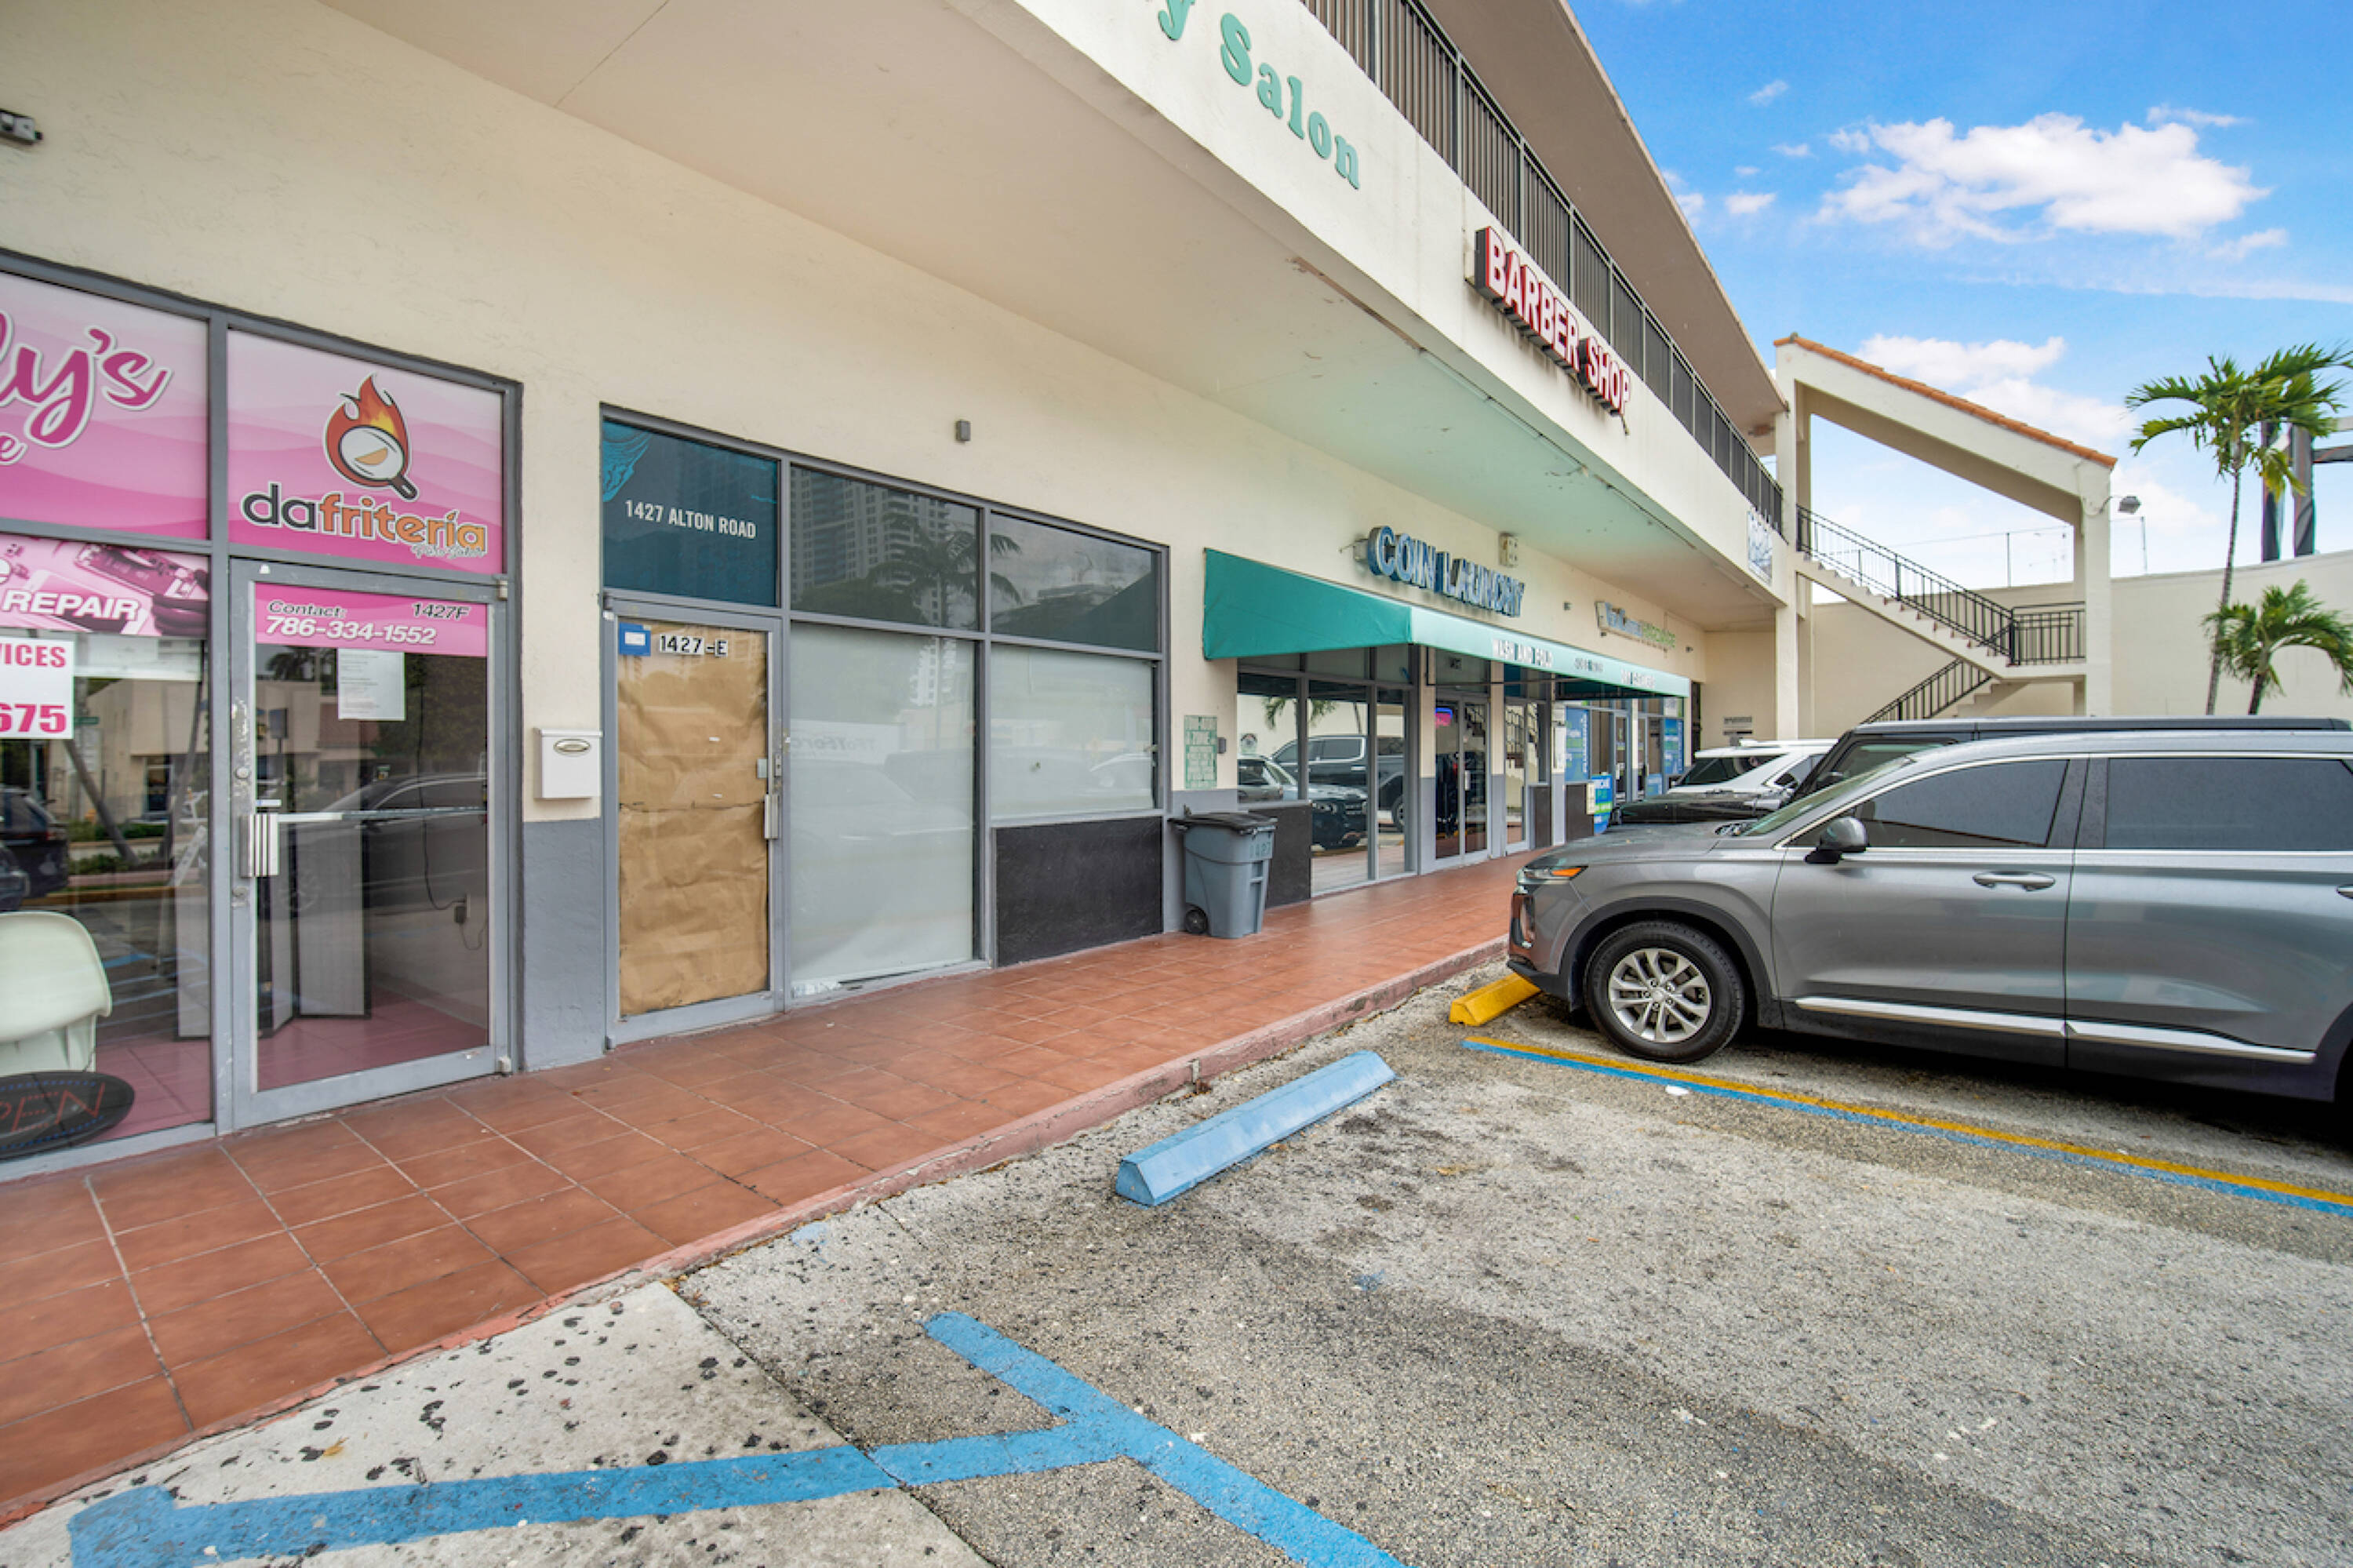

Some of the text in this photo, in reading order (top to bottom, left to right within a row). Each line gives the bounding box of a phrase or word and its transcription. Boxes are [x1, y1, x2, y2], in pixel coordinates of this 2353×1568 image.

[1220, 13, 1360, 190] Salon
[1482, 225, 1631, 419] BARBER SHOP
[625, 500, 757, 540] 1427 ALTON ROAD
[1369, 526, 1525, 617] COIN LAUNDRY
[2, 589, 140, 621] REPAIR
[267, 600, 471, 621] Contact: 1427F
[265, 615, 438, 646] 786-334-1552
[0, 642, 67, 668] ICES
